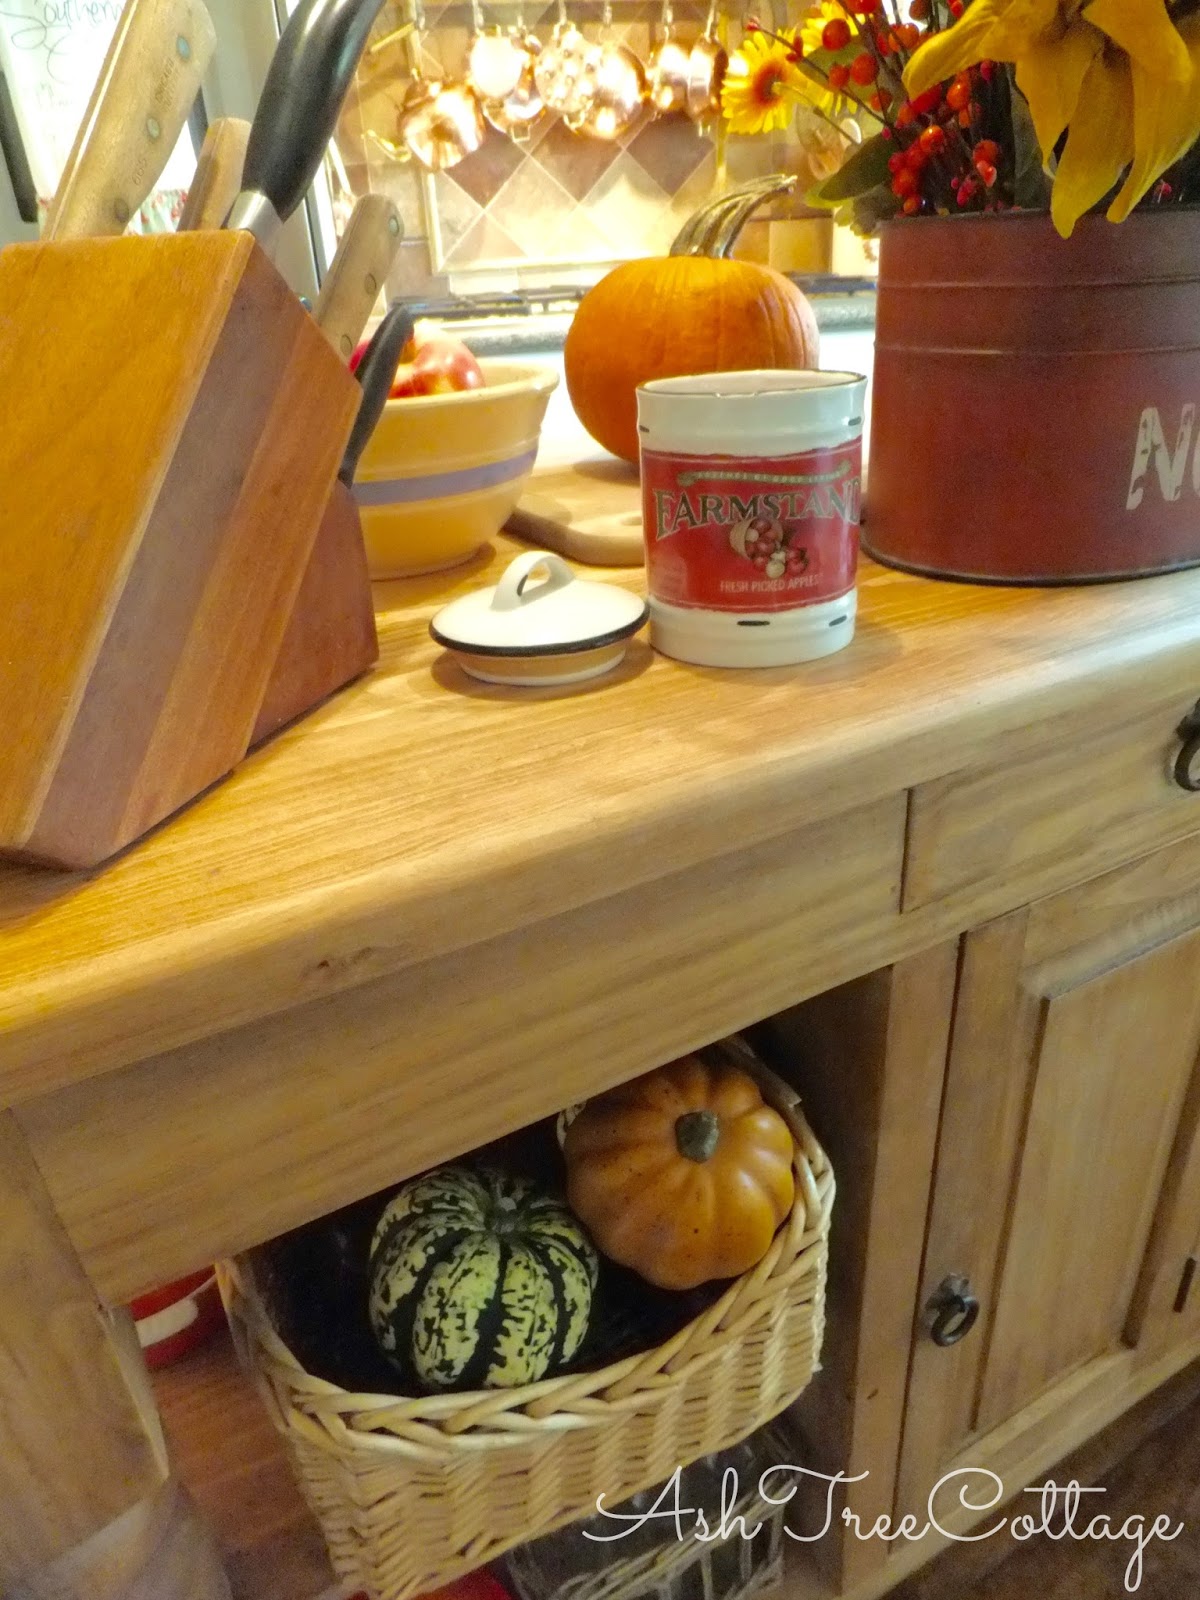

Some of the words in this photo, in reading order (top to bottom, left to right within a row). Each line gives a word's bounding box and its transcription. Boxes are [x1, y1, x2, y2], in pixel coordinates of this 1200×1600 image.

[1125, 402, 1200, 511] N
[720, 580, 749, 593] FRESH
[751, 579, 786, 592] PICKED
